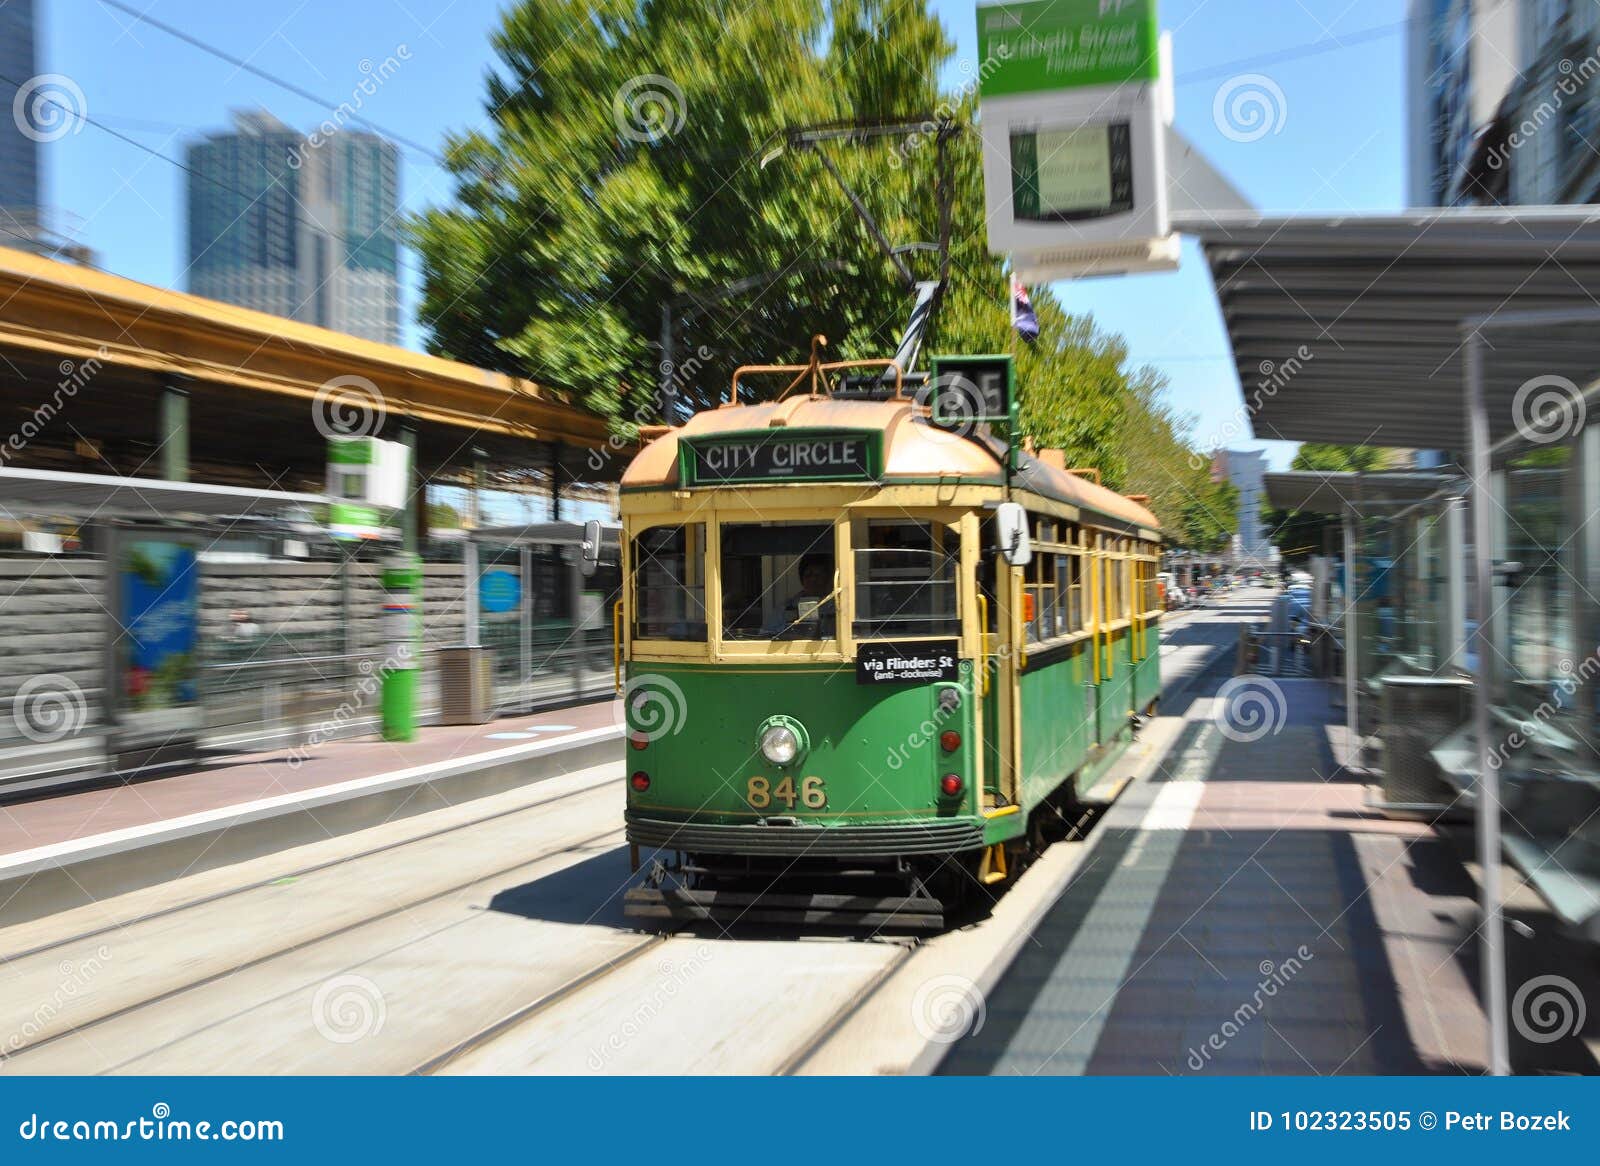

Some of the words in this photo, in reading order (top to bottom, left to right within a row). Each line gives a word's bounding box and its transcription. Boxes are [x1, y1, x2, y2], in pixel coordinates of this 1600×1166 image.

[706, 443, 760, 469] CITY
[772, 440, 857, 466] CIRCLE
[863, 658, 884, 671] via
[886, 656, 936, 670] Flinders
[938, 655, 954, 668] St
[747, 775, 826, 809] 846
